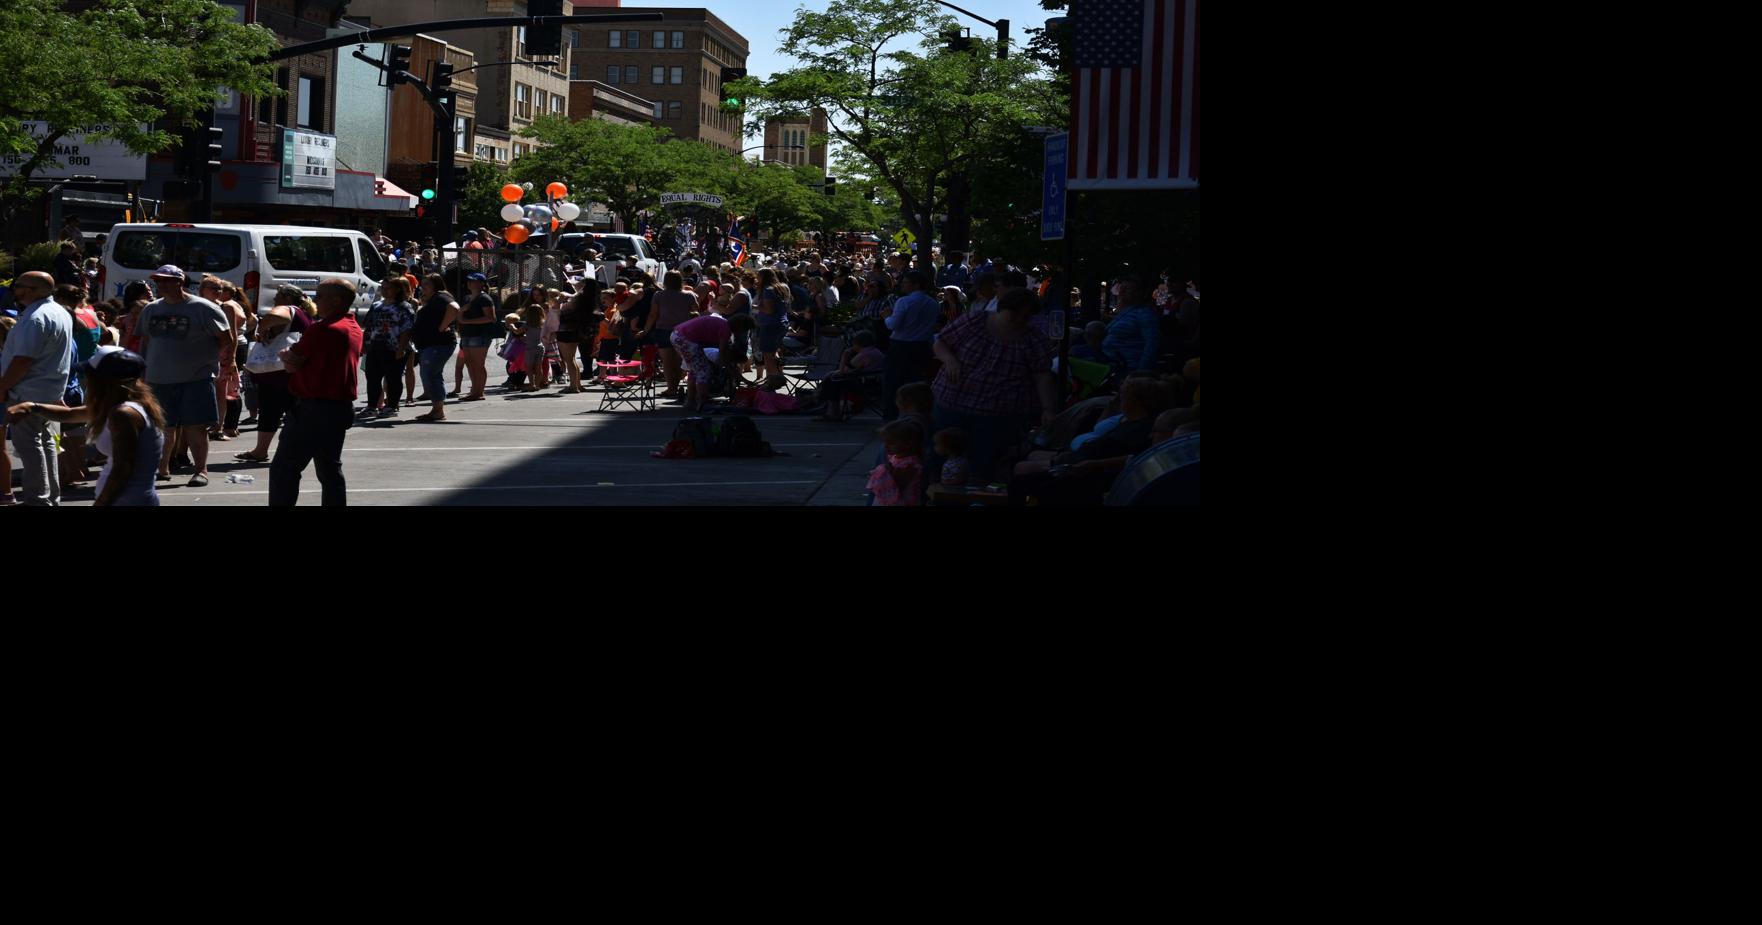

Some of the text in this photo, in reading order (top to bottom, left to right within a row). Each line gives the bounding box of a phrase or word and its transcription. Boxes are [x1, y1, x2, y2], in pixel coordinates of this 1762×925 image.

[68, 156, 91, 165] 800
[661, 194, 721, 204] EQUAL RIGHTS
